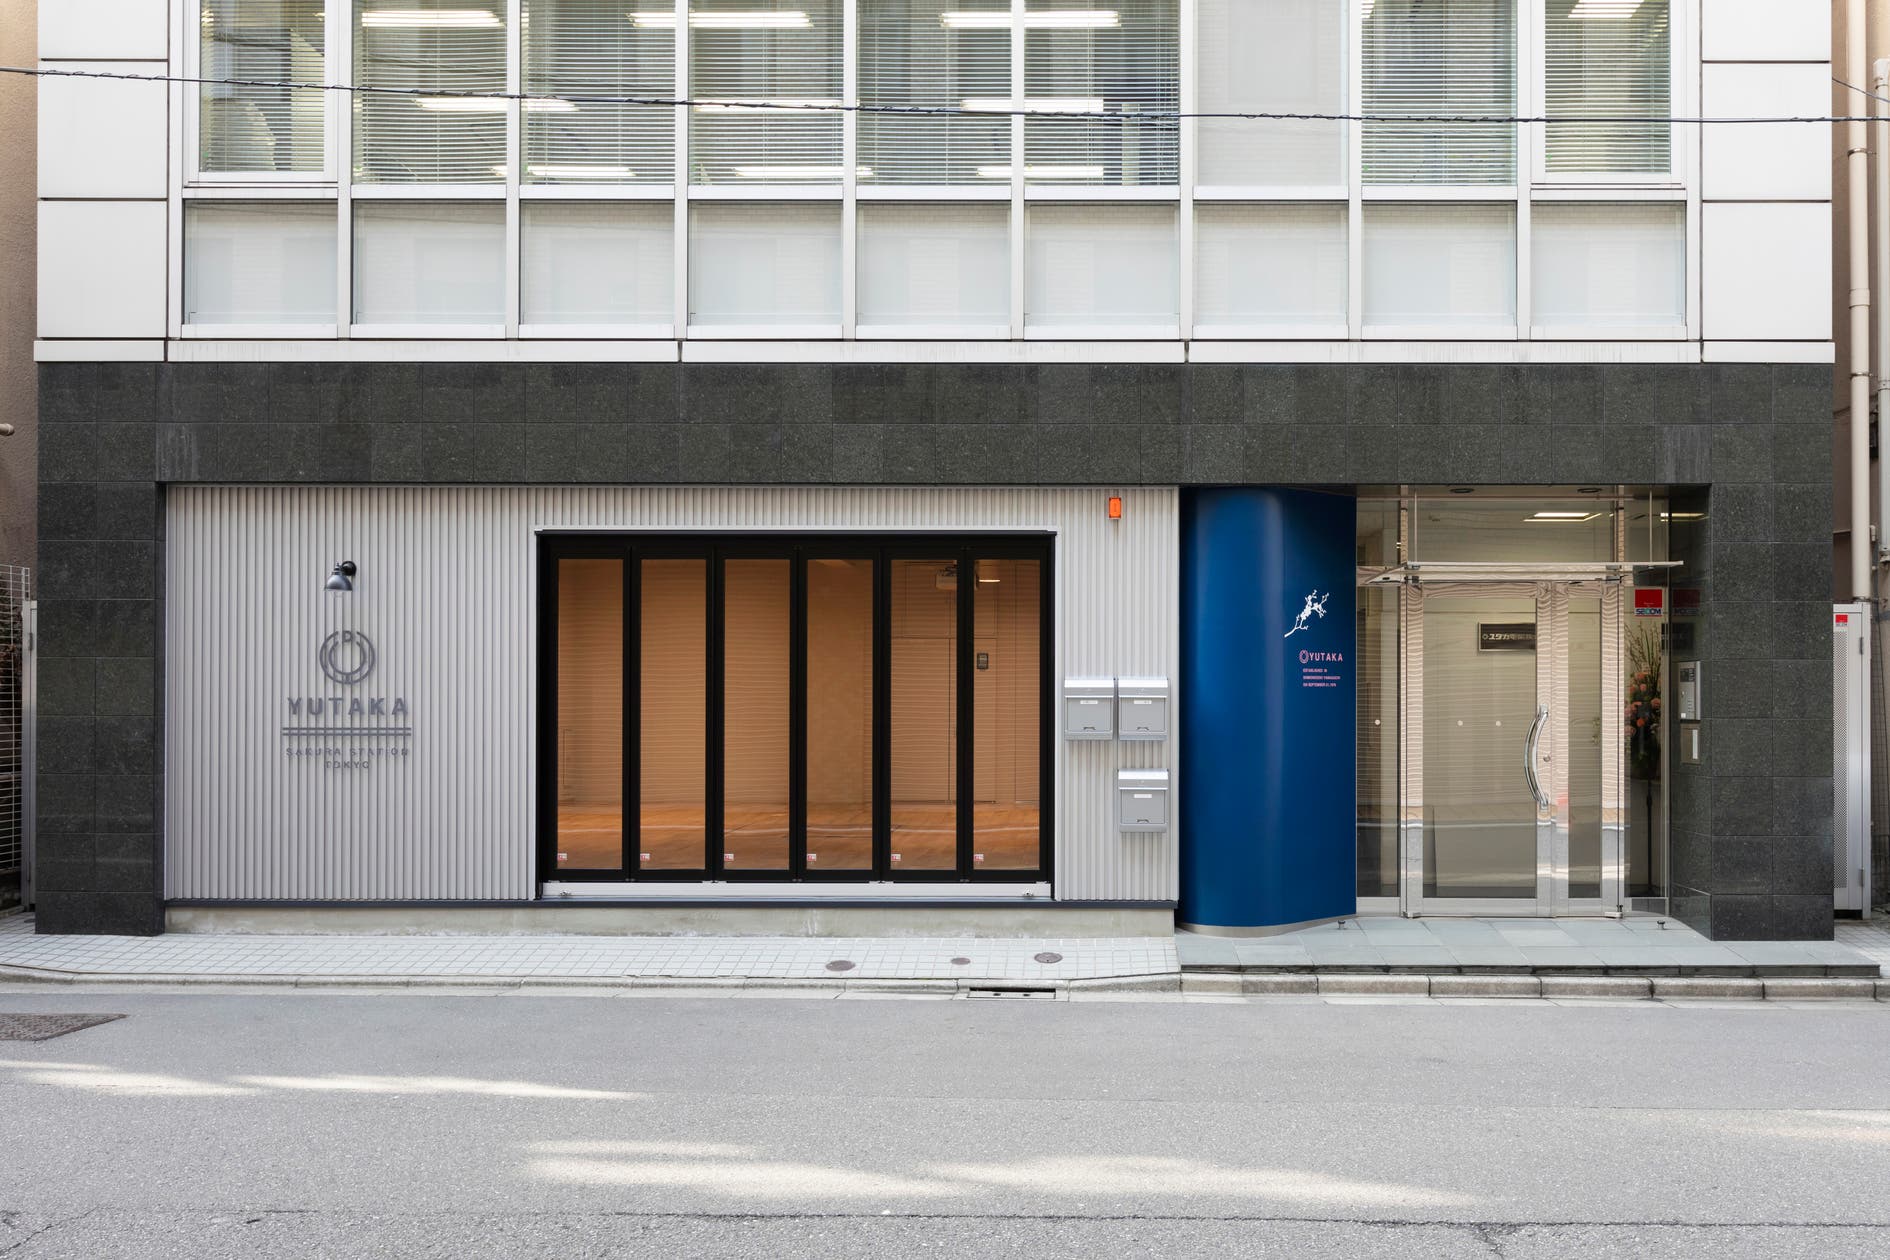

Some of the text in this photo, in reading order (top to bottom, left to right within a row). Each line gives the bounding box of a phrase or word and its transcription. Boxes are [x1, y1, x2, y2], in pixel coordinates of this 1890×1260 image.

[1309, 653, 1343, 662] YUTAKA
[288, 697, 409, 715] YUTAKA
[286, 748, 409, 756] SAKURA STATION
[325, 761, 370, 769] TOKYO
